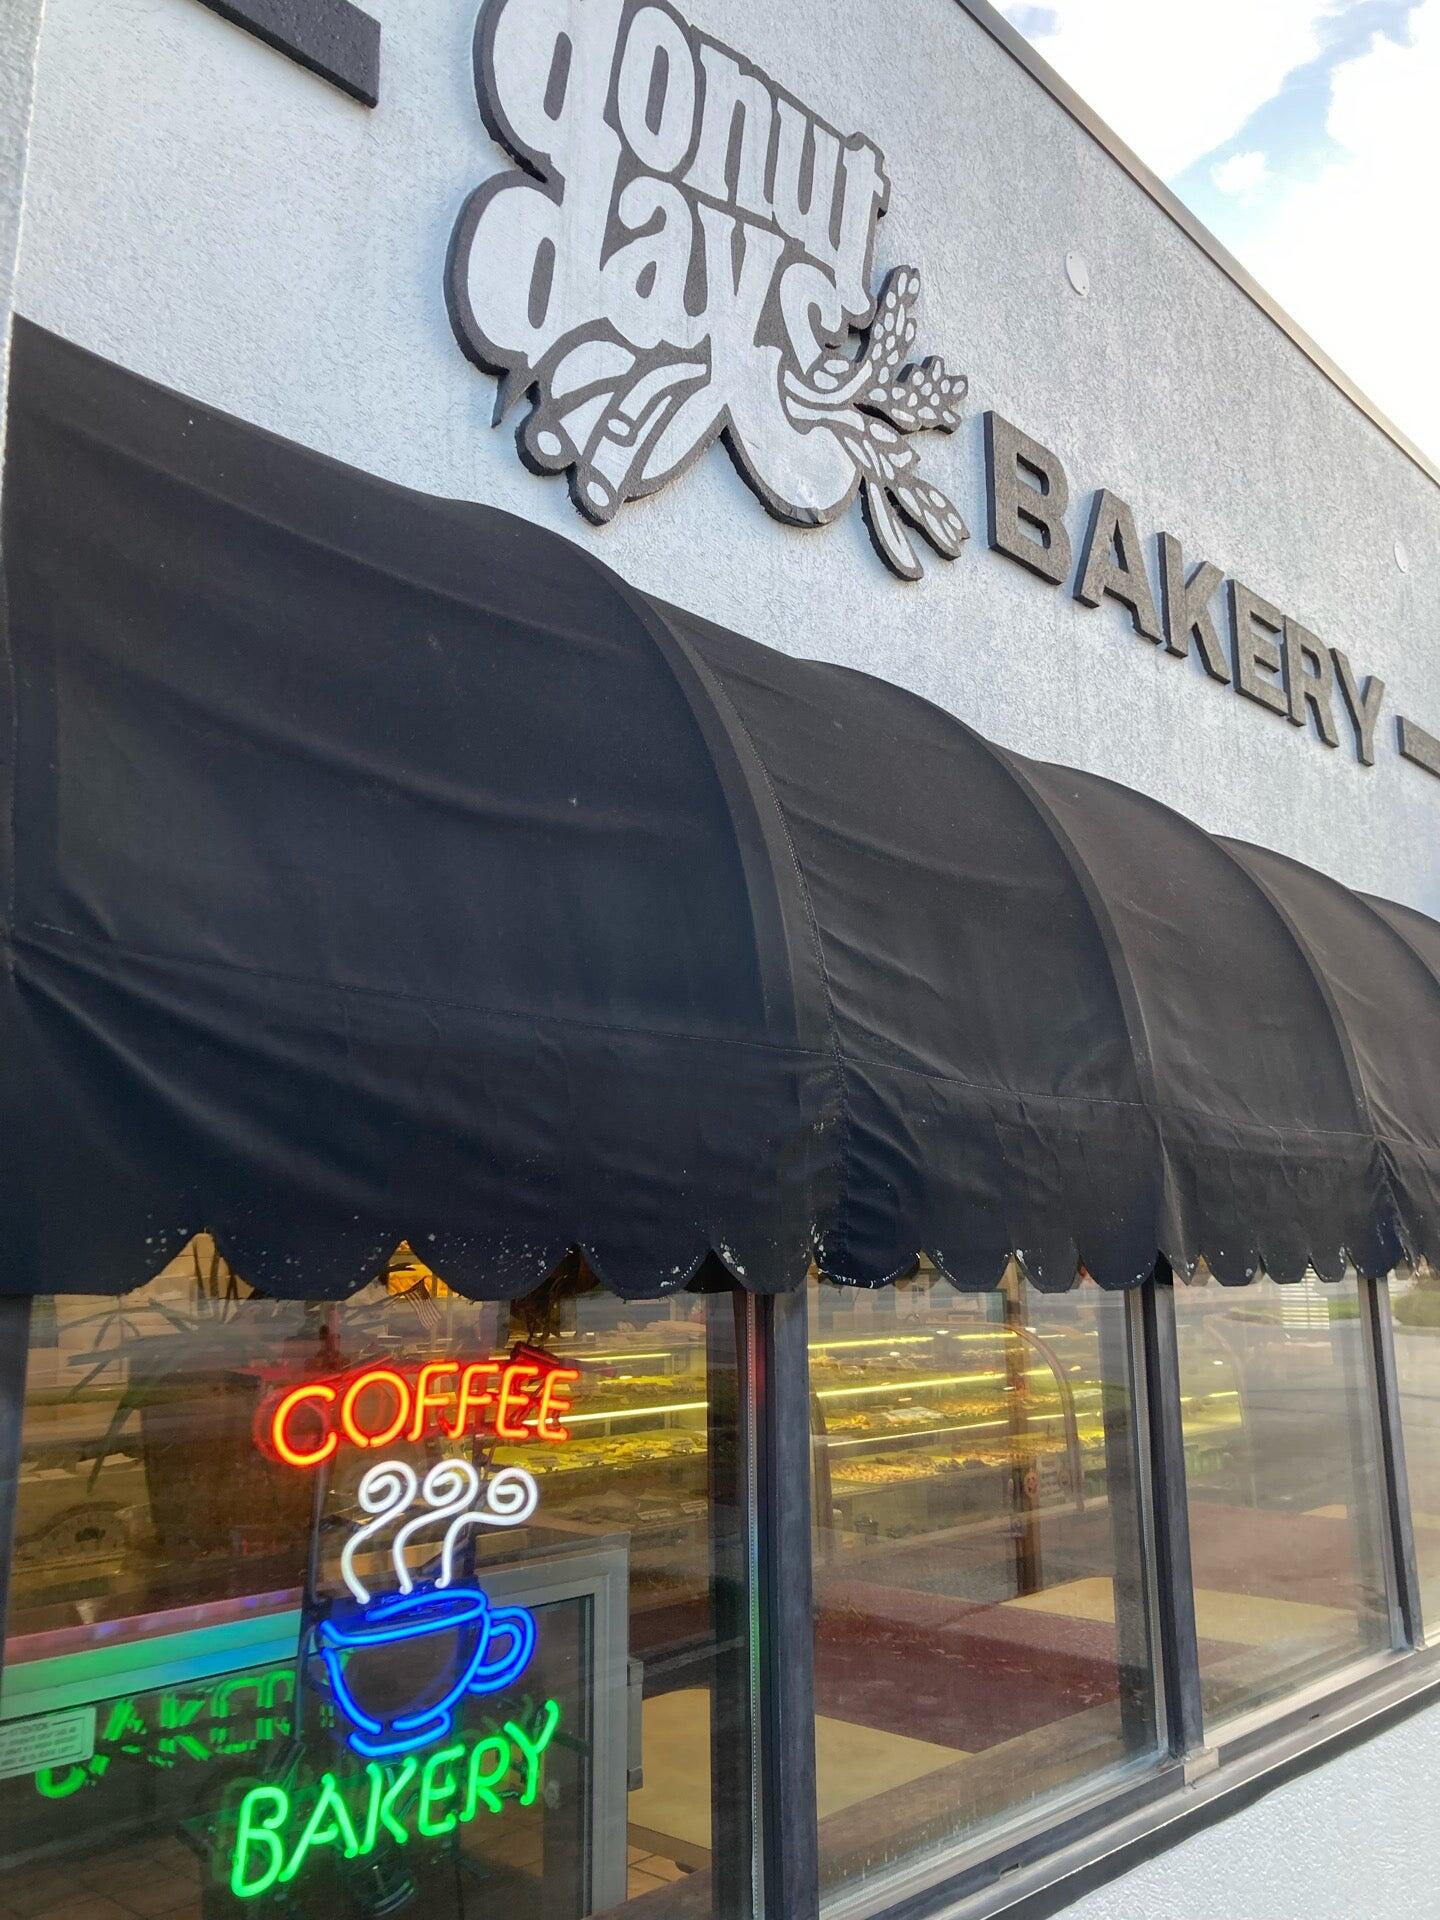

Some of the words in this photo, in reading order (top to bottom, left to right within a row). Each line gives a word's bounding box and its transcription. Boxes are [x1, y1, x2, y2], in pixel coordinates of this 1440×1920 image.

[484, 0, 888, 318] donut
[983, 410, 1385, 766] BAKERY
[271, 1360, 580, 1467] COFFEE
[230, 1698, 560, 1898] BAKERY
